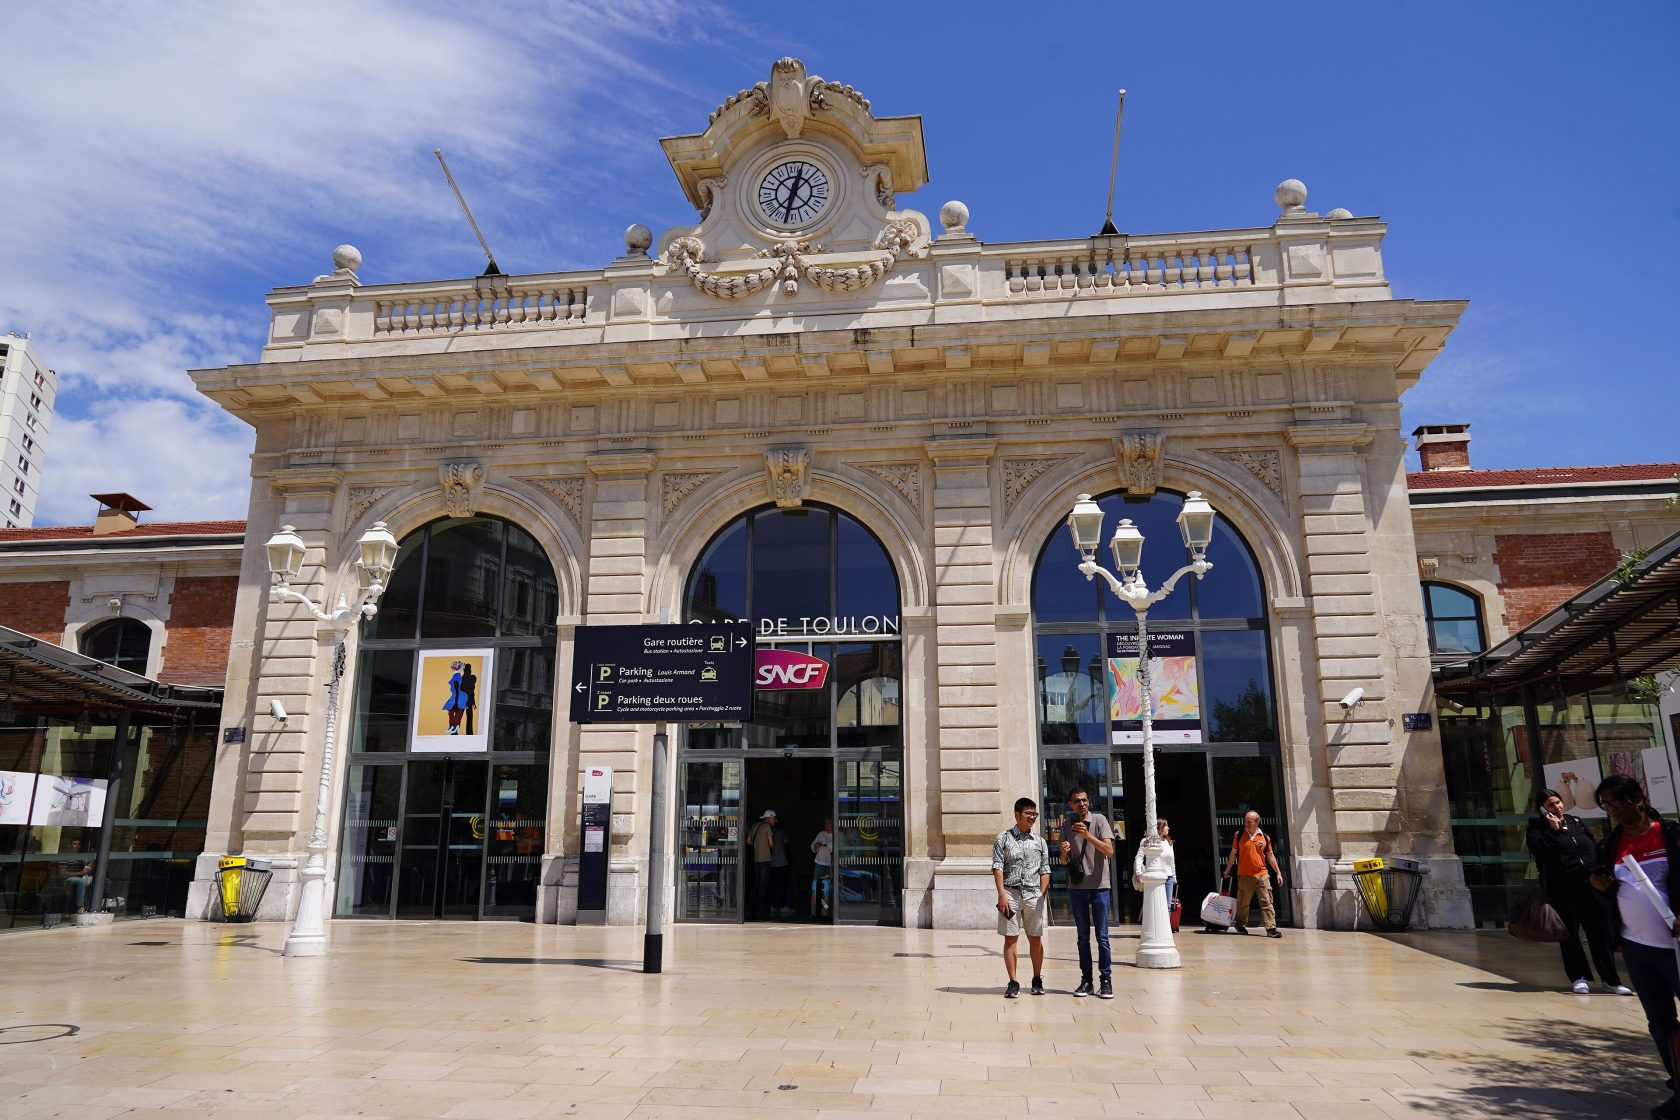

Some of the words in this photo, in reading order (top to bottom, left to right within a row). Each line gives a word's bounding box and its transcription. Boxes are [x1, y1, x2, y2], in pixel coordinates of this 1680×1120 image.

[761, 618, 788, 634] DE
[800, 615, 899, 634] TOULON
[644, 638, 665, 646] Gare
[667, 637, 703, 646] routière
[600, 666, 611, 680] P
[619, 667, 653, 677] Parking
[755, 664, 823, 686] SNCF
[598, 694, 609, 709] P
[617, 695, 652, 706] Parking
[653, 695, 676, 704] deux
[677, 696, 704, 704] roues
